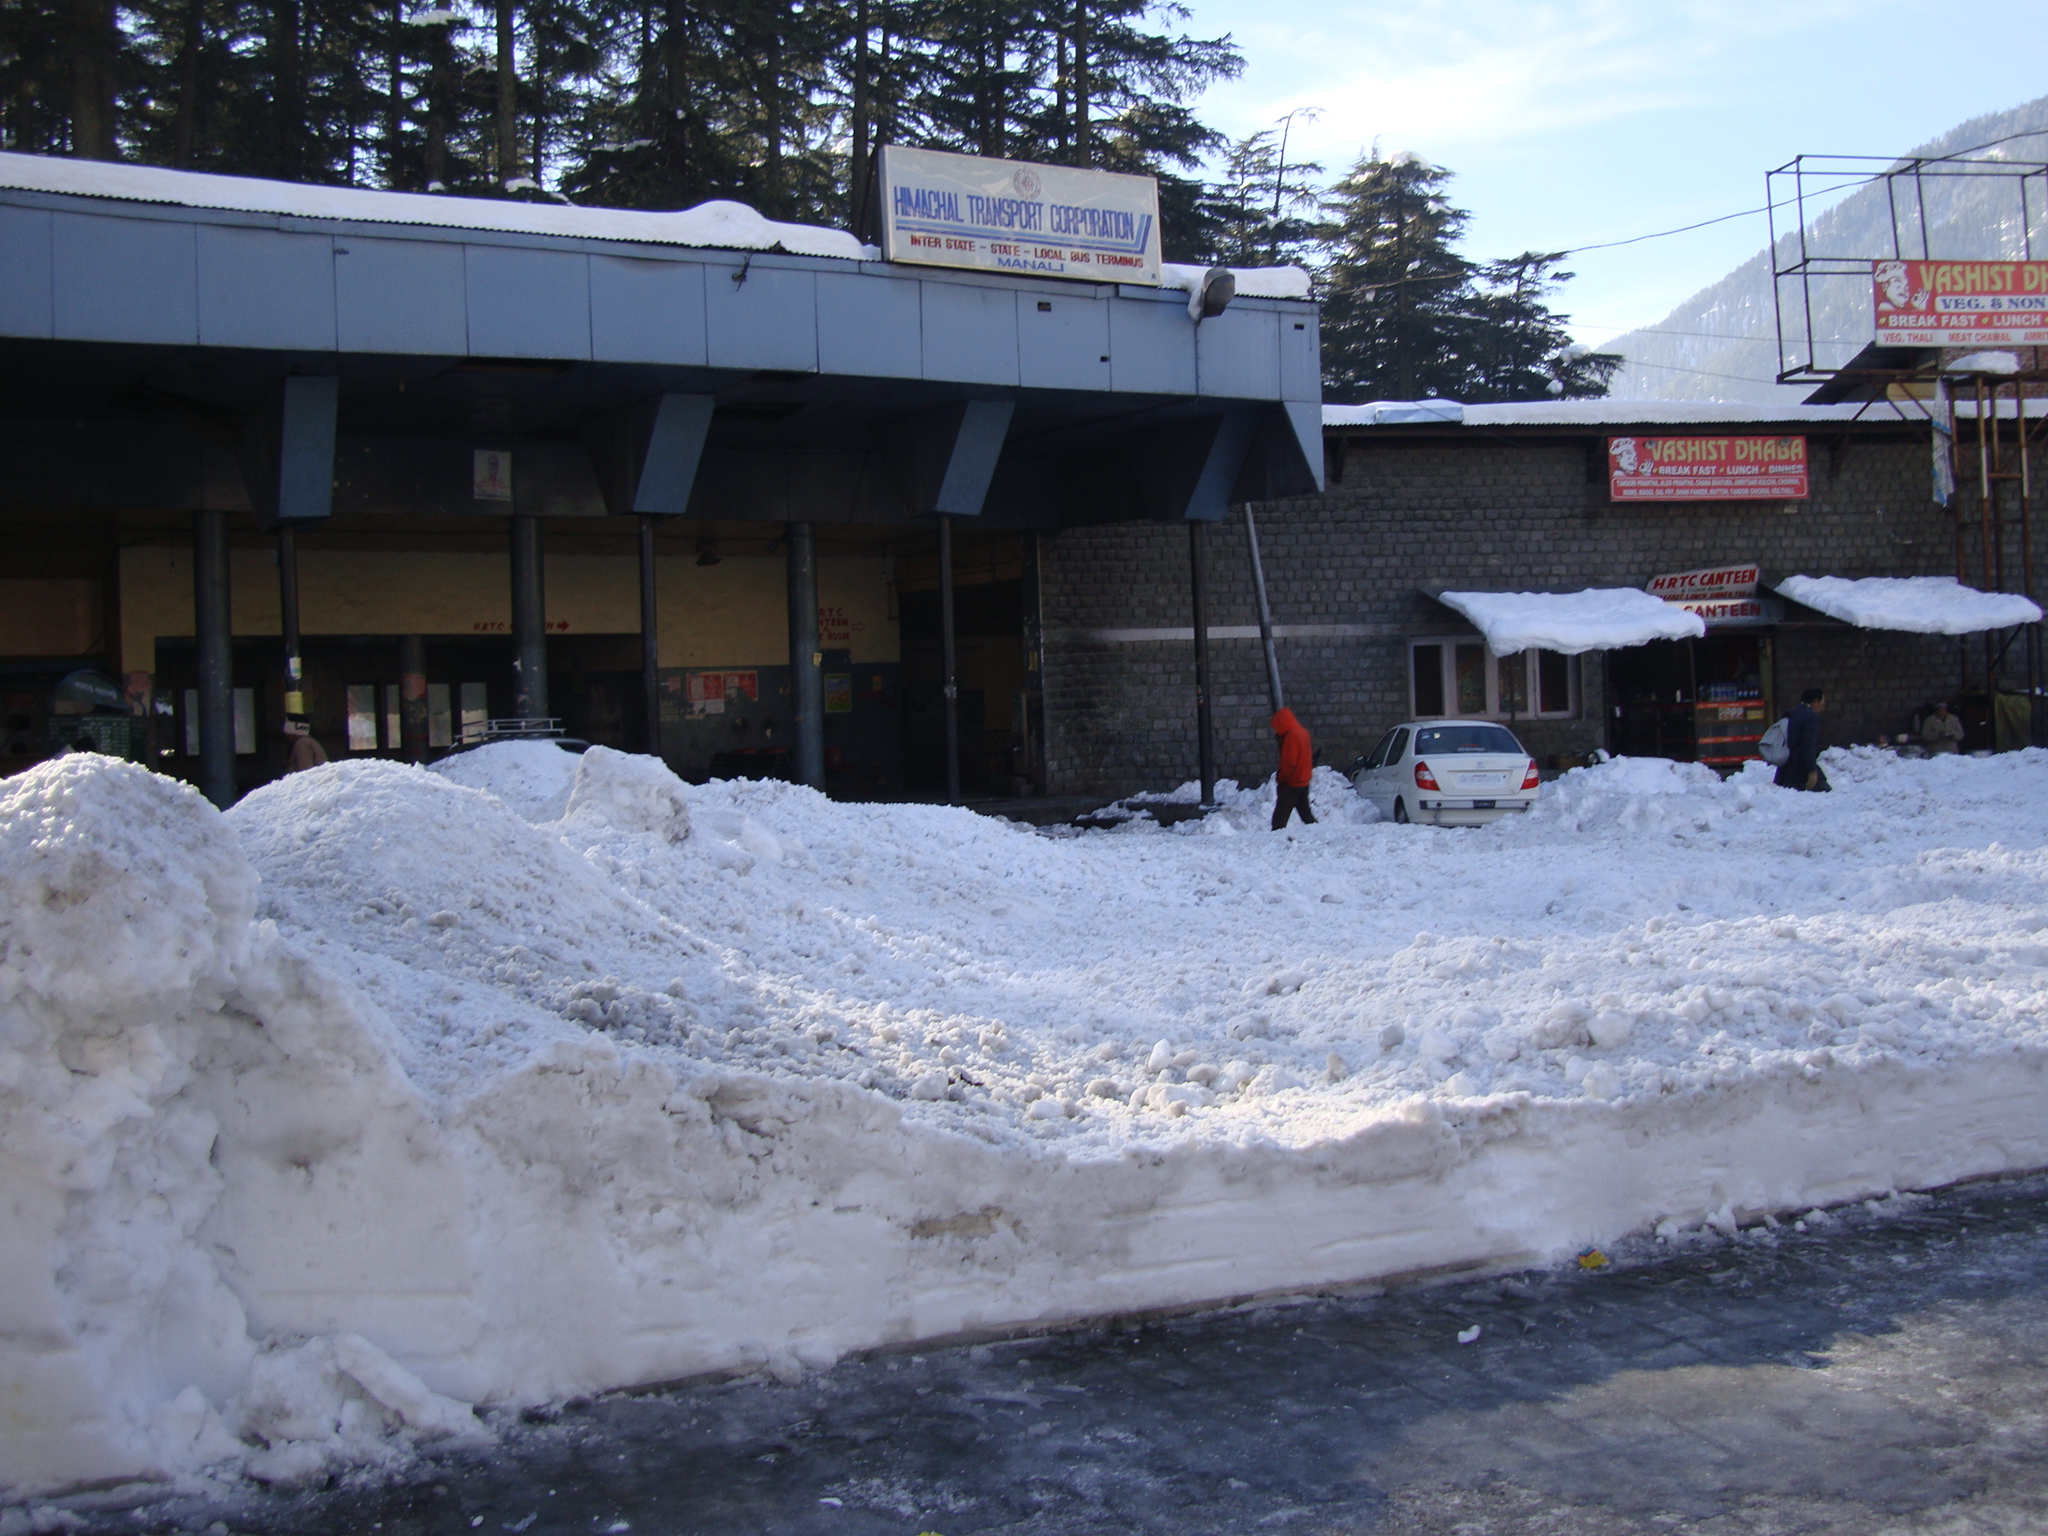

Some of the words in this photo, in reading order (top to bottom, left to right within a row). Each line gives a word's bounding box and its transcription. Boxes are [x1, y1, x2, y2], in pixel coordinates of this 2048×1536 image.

[893, 186, 964, 222] HIMACHAL
[967, 194, 1044, 231] TRANSPORT
[1050, 204, 1135, 241] CORPORATION
[910, 235, 941, 248] INTER
[945, 238, 976, 252] STATE
[990, 243, 1020, 256] STATE
[1034, 247, 1067, 261] LOCAL
[1070, 251, 1091, 263] BUS
[1095, 253, 1144, 268] TERMINUS
[997, 257, 1065, 272] MANALI
[1919, 264, 2016, 294] VASHIST
[1941, 298, 1986, 310] VEG.
[1888, 314, 1938, 327] BREAK
[1940, 314, 1978, 327] FAST
[1993, 314, 2042, 327] LUNCH
[1651, 439, 1729, 463] VASHIST
[1658, 465, 1691, 475] BREAK
[1693, 465, 1717, 475] FAST
[1726, 465, 1759, 475] LUNCH
[1652, 575, 1698, 590] HRTC
[1700, 569, 1756, 586] CANTEEN
